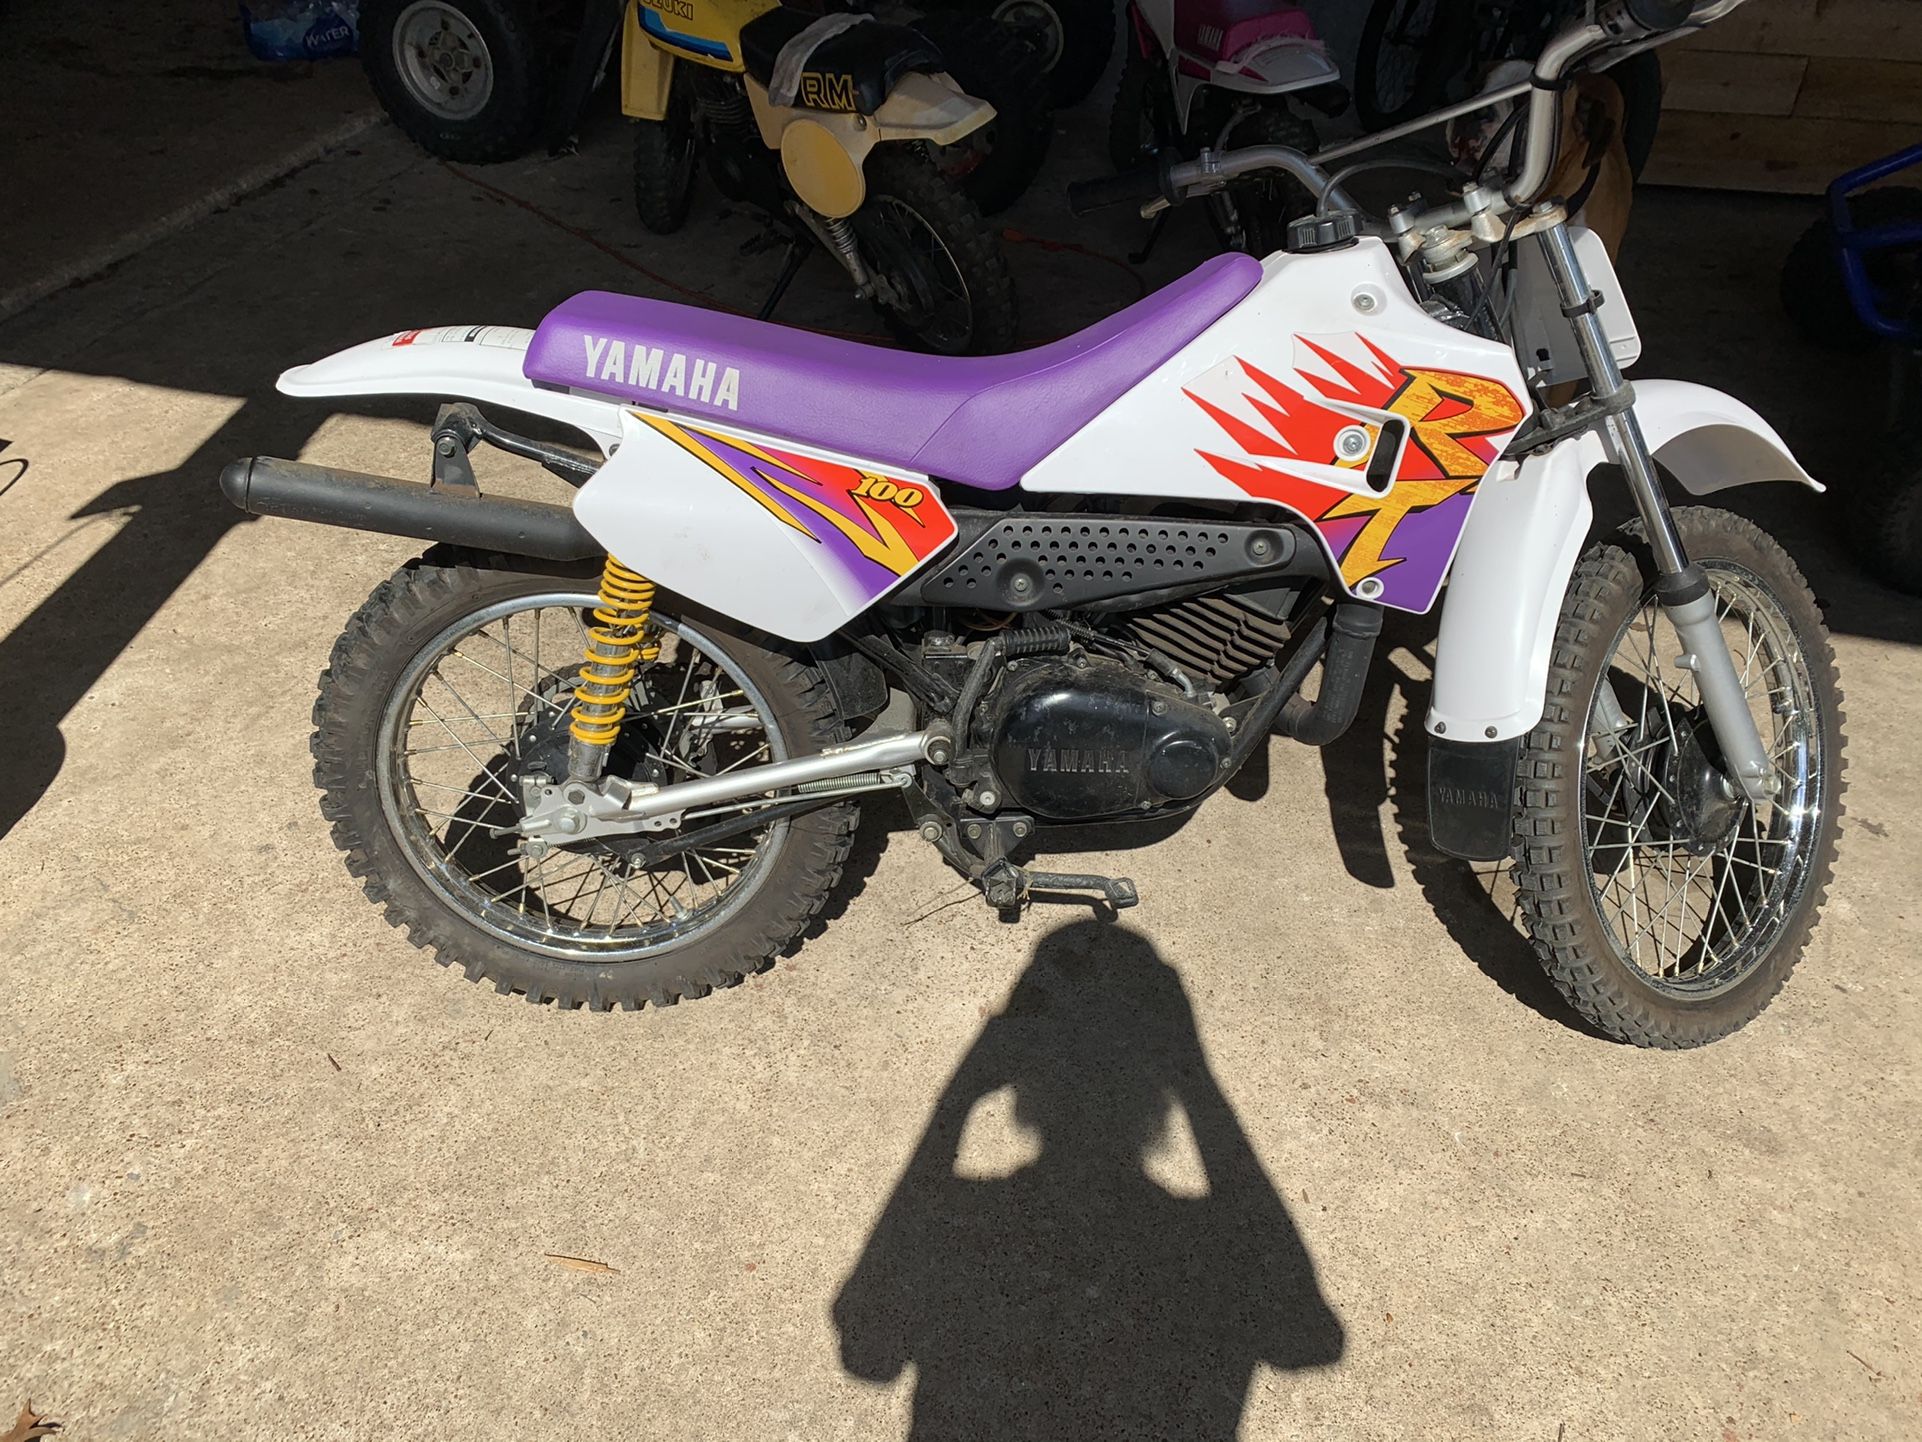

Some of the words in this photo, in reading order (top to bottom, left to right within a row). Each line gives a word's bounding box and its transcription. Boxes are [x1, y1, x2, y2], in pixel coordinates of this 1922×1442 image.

[800, 71, 857, 112] RM
[584, 334, 740, 411] YAMAHA
[851, 475, 924, 507] 100
[1027, 748, 1130, 773] YAMAHA
[1439, 786, 1498, 809] YAMAHA
